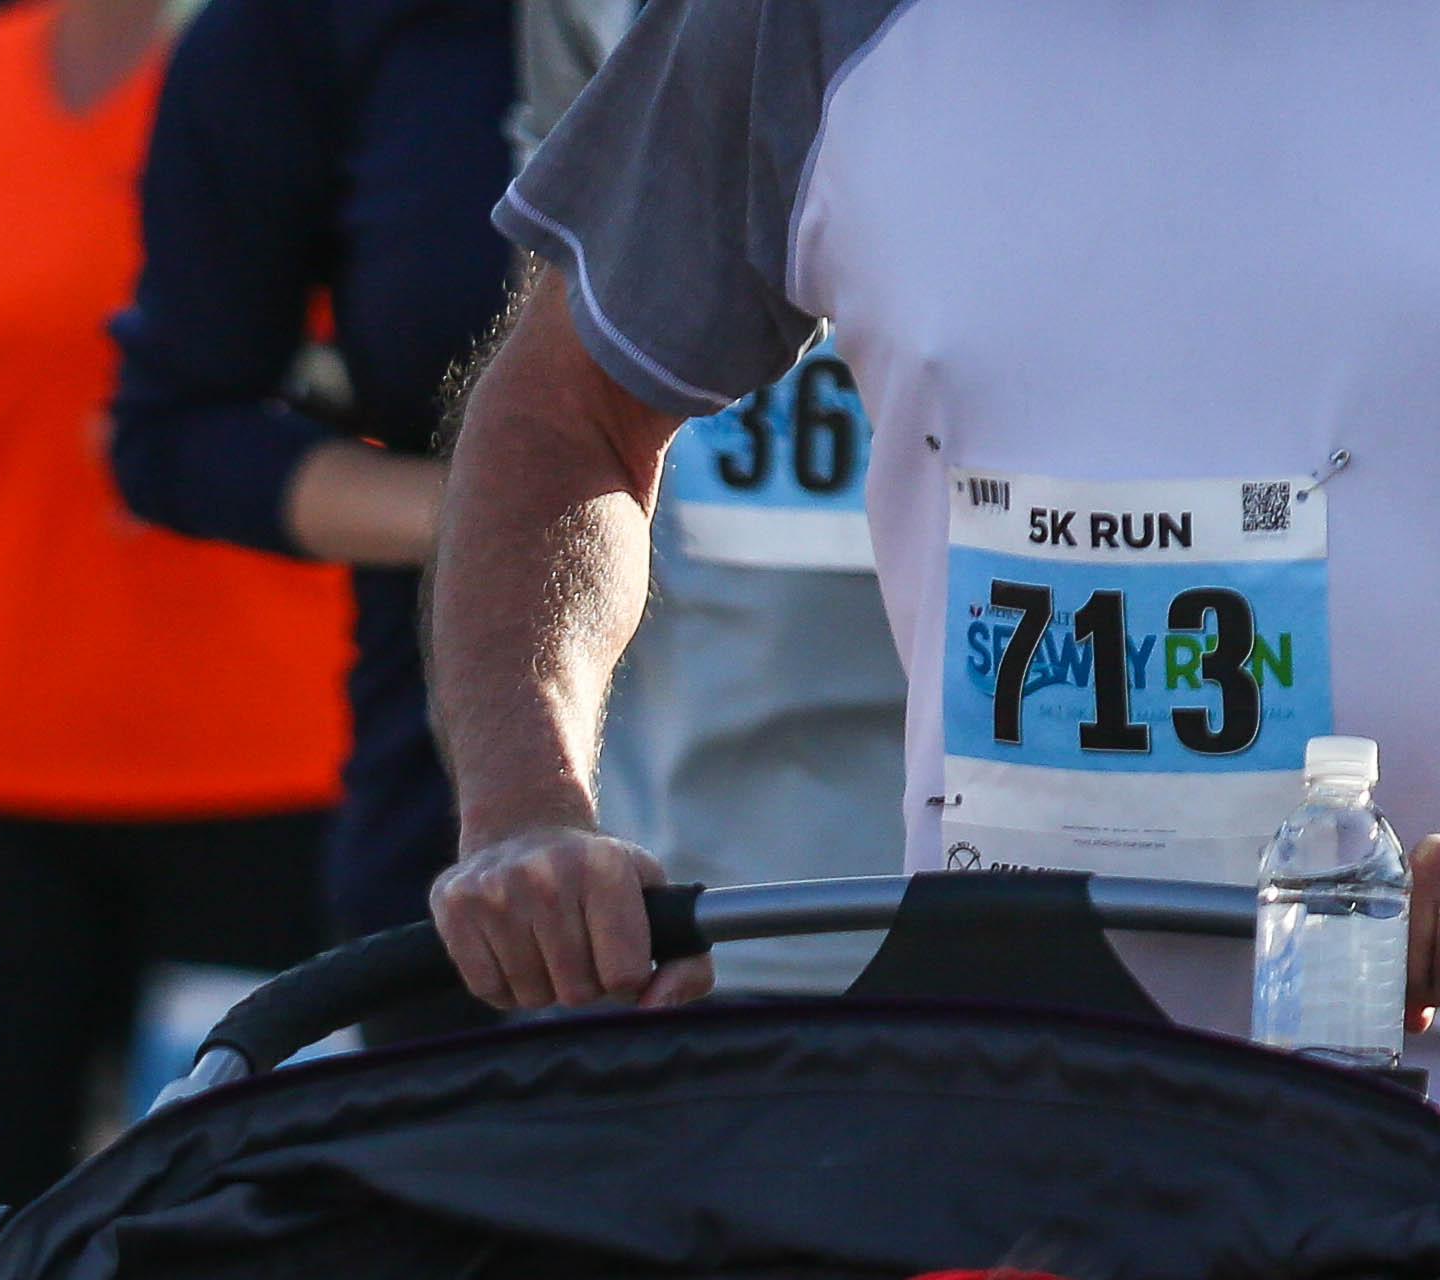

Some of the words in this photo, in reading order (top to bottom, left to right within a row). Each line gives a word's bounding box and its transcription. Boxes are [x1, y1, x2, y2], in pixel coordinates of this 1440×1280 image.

[1028, 506, 1078, 547] 5K
[1089, 511, 1193, 549] RUN
[989, 577, 1261, 755] 713
[1165, 632, 1293, 690] RN
